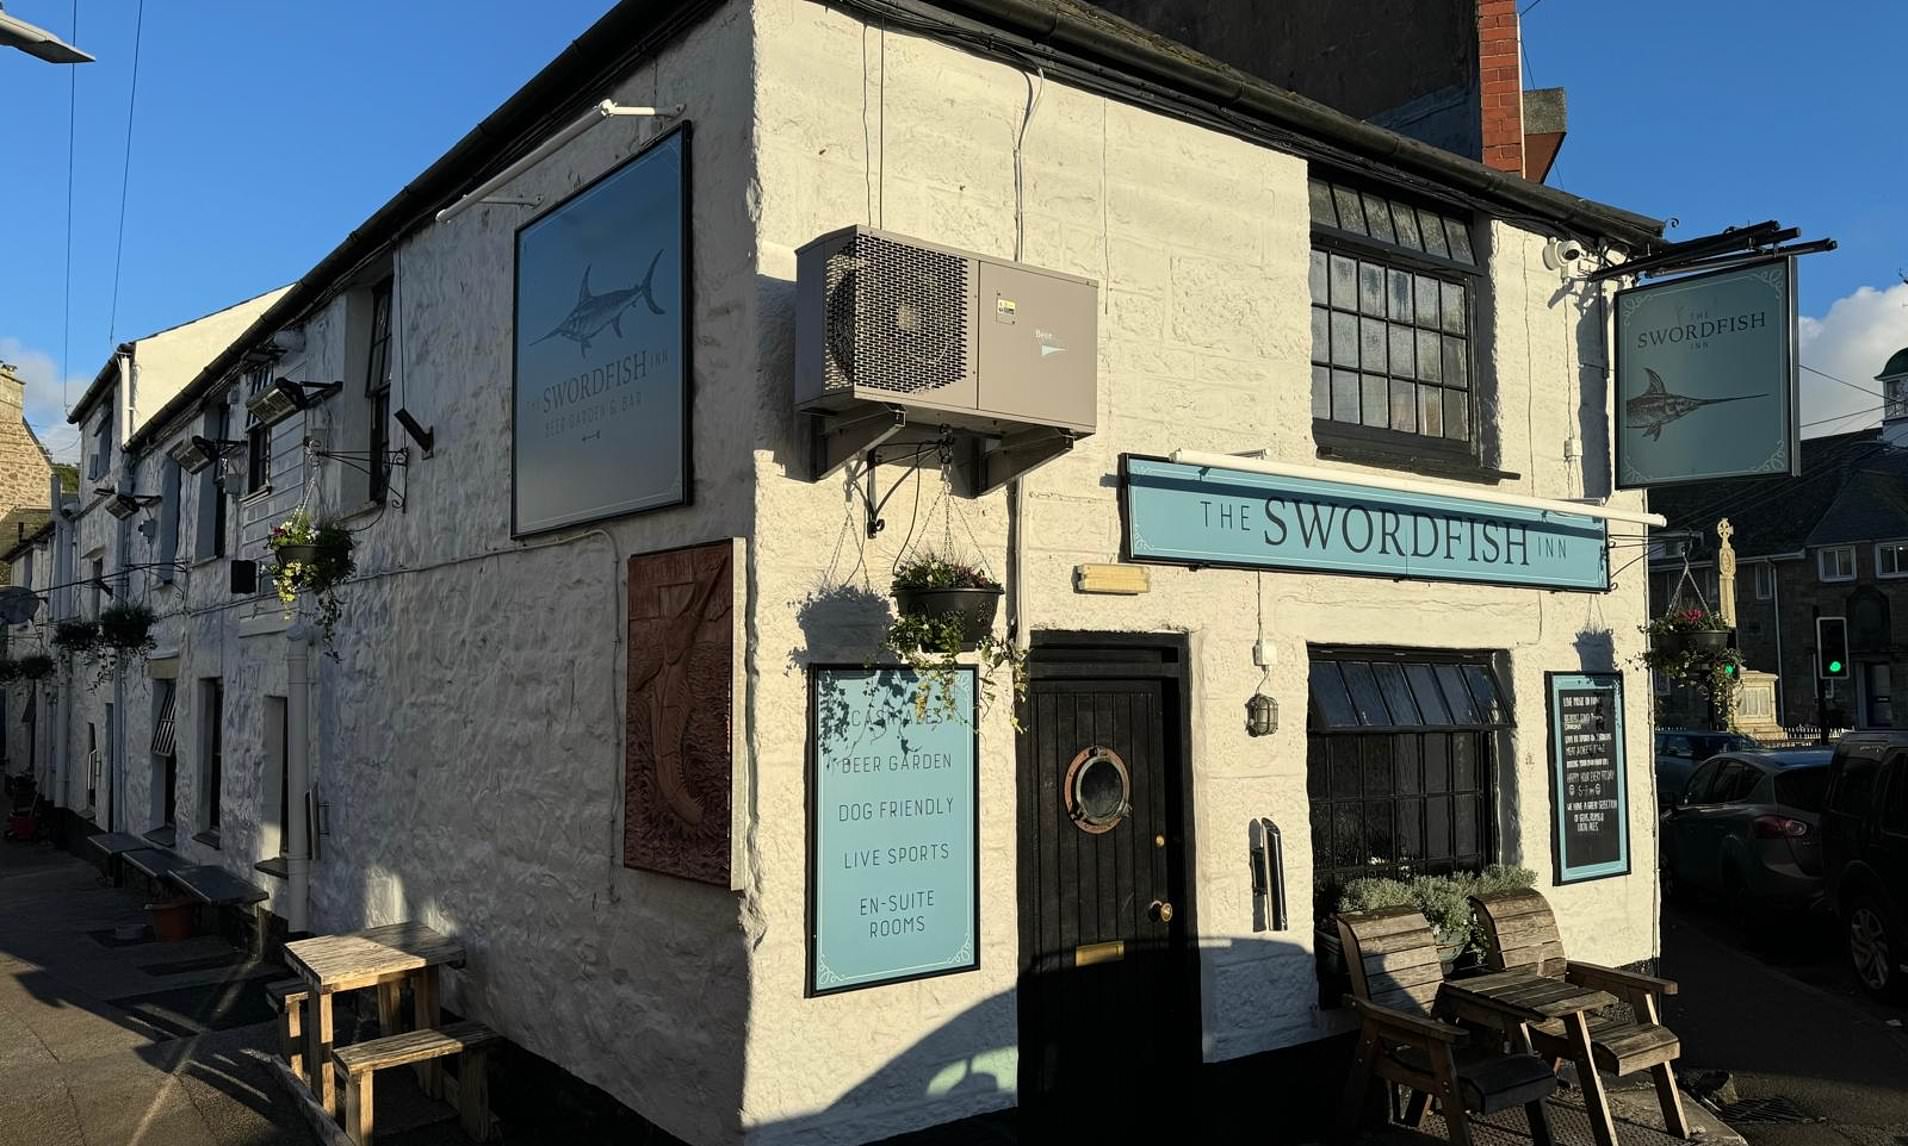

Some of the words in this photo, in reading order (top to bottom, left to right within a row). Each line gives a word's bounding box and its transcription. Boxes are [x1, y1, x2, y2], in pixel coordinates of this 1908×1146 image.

[1690, 311, 1709, 320] THE
[1638, 312, 1766, 349] SWORDFISH
[1690, 341, 1709, 350] INN
[543, 350, 647, 413] SWORDFISH
[1200, 500, 1252, 531] THE
[1264, 497, 1530, 566] SWORDFISH
[1537, 538, 1568, 560] INN
[842, 756, 881, 774] BEER
[889, 753, 952, 772] GARDEN
[839, 803, 873, 823] DOG
[880, 798, 954, 817] FRIENDLY
[844, 849, 880, 869] LIVE
[887, 843, 950, 864] SPORTS
[860, 890, 935, 916] EN-SUITE
[870, 916, 925, 938] ROOMS
